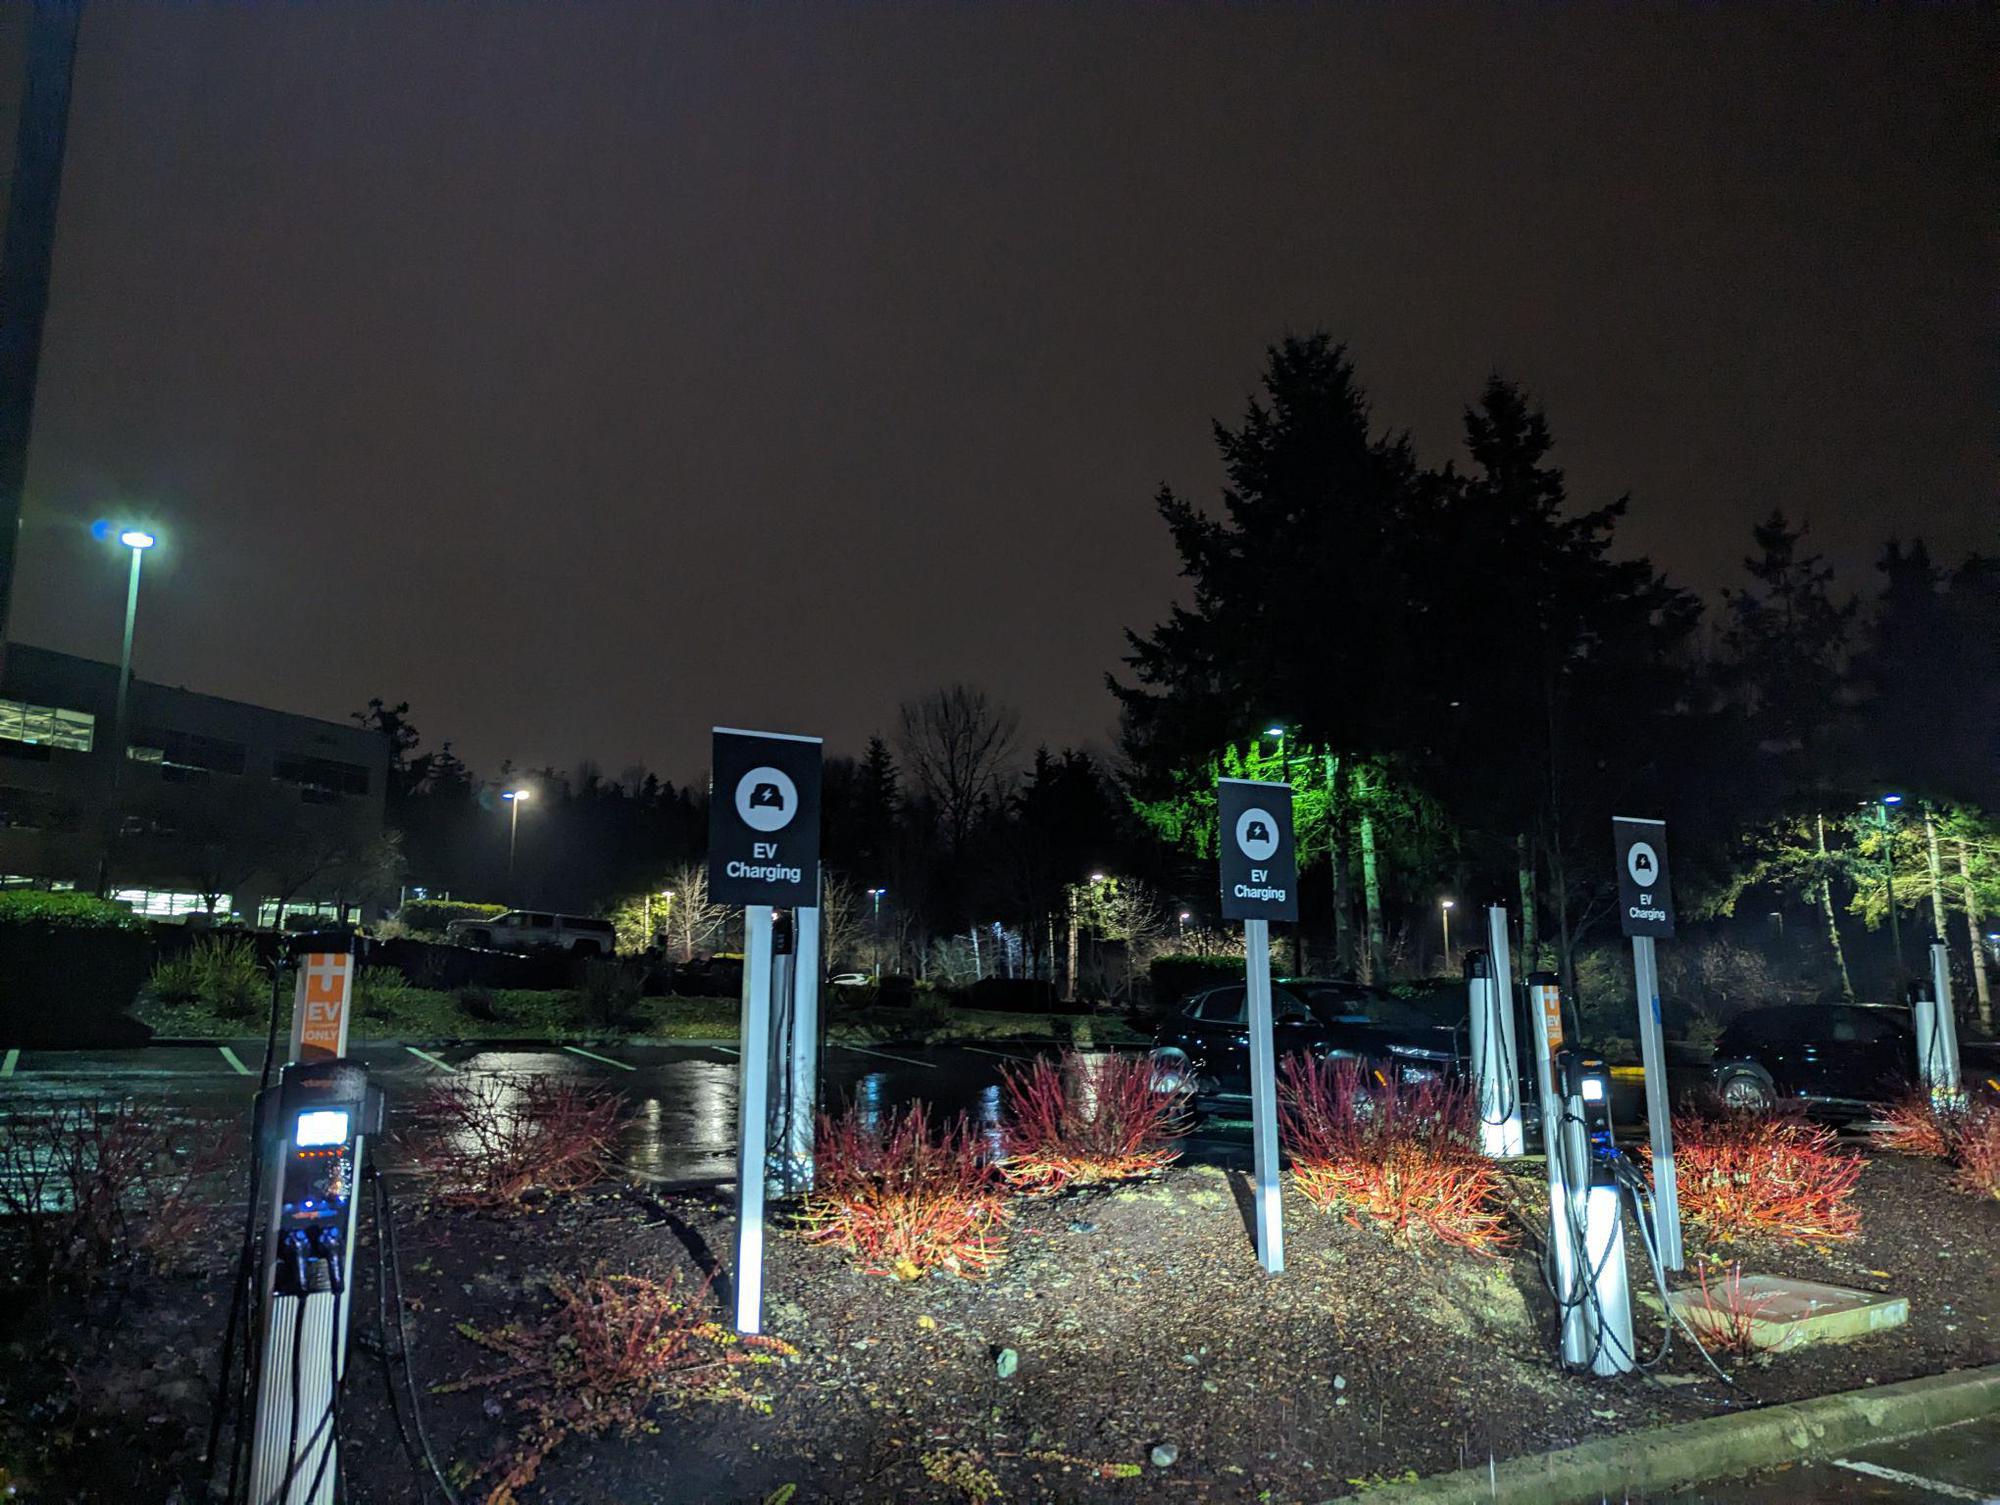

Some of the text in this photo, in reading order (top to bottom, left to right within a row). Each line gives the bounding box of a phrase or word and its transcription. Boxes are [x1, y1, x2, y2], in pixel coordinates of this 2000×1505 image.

[753, 842, 778, 859] EV
[726, 860, 801, 884] Charging
[1251, 869, 1268, 882] EV
[1233, 884, 1286, 902] Charging
[1639, 893, 1652, 905] EV
[1629, 906, 1666, 921] Charging
[308, 1001, 341, 1022] EV
[304, 1029, 339, 1041] ONLY
